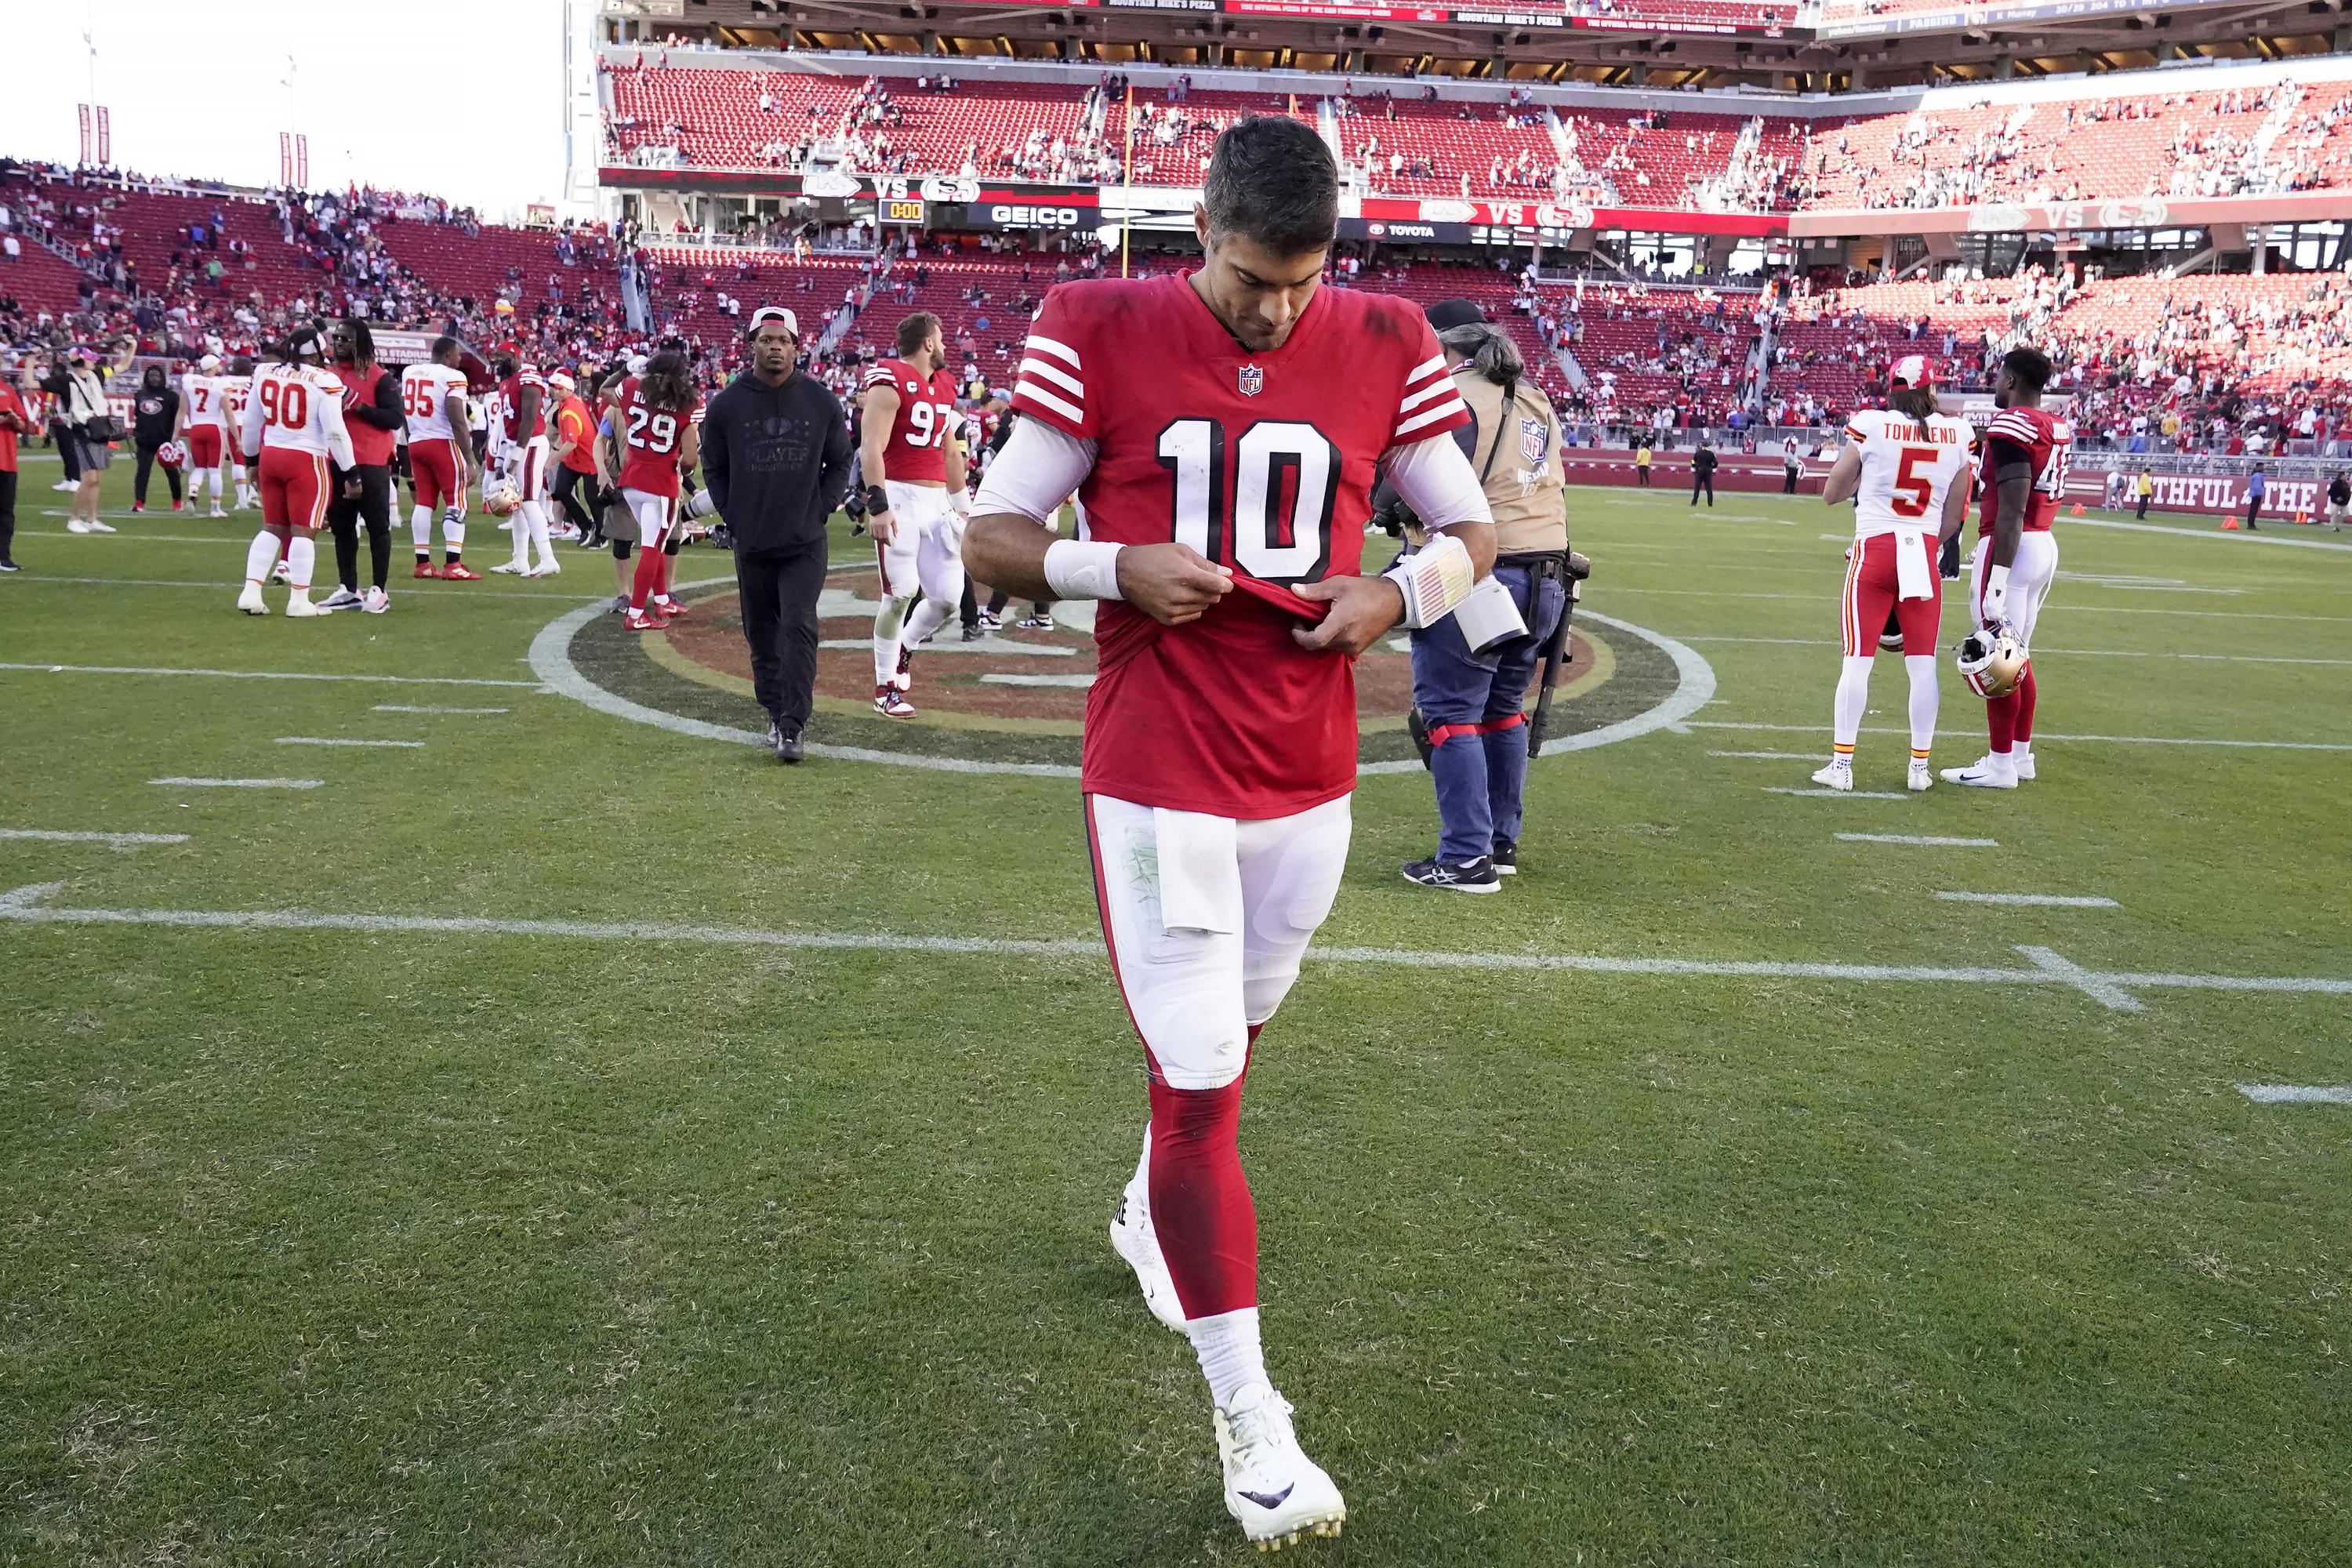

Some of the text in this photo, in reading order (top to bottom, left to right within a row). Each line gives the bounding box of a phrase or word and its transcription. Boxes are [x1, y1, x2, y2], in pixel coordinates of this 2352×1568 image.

[872, 176, 908, 198] VS
[890, 202, 921, 220] 0:00
[991, 205, 1078, 226] GEICO
[1487, 202, 1523, 225] VS
[2043, 202, 2083, 229] VS
[1388, 225, 1435, 238] TOYOTA
[194, 388, 209, 412] 7
[260, 379, 307, 430] 90
[403, 379, 434, 417] 95
[627, 405, 677, 453] 29
[905, 401, 952, 448] 97
[1884, 423, 1957, 445] TOWNEND
[1524, 435, 1544, 457] NFL
[1890, 445, 1940, 517] 5
[2111, 474, 2237, 509] ATHFUL
[2261, 481, 2318, 513] THE
[1156, 416, 1341, 586] 10
